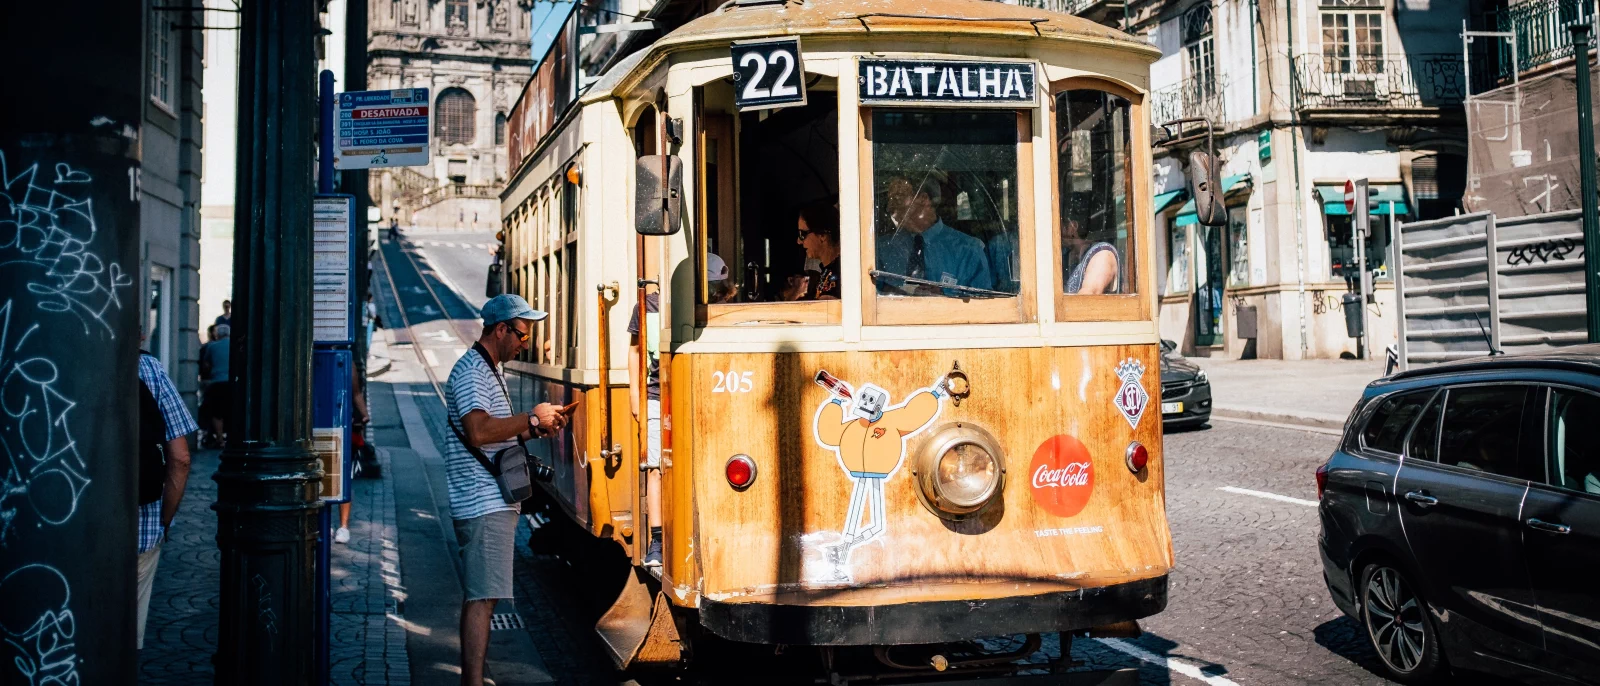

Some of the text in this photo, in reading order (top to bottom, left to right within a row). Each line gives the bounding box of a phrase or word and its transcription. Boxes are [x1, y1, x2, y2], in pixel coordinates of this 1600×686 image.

[739, 50, 798, 99] 22
[866, 65, 1027, 98] BATALHA
[360, 108, 420, 118] DESATIVADA
[711, 370, 753, 393] 205
[1034, 525, 1103, 537] TASTE THE FEELING
